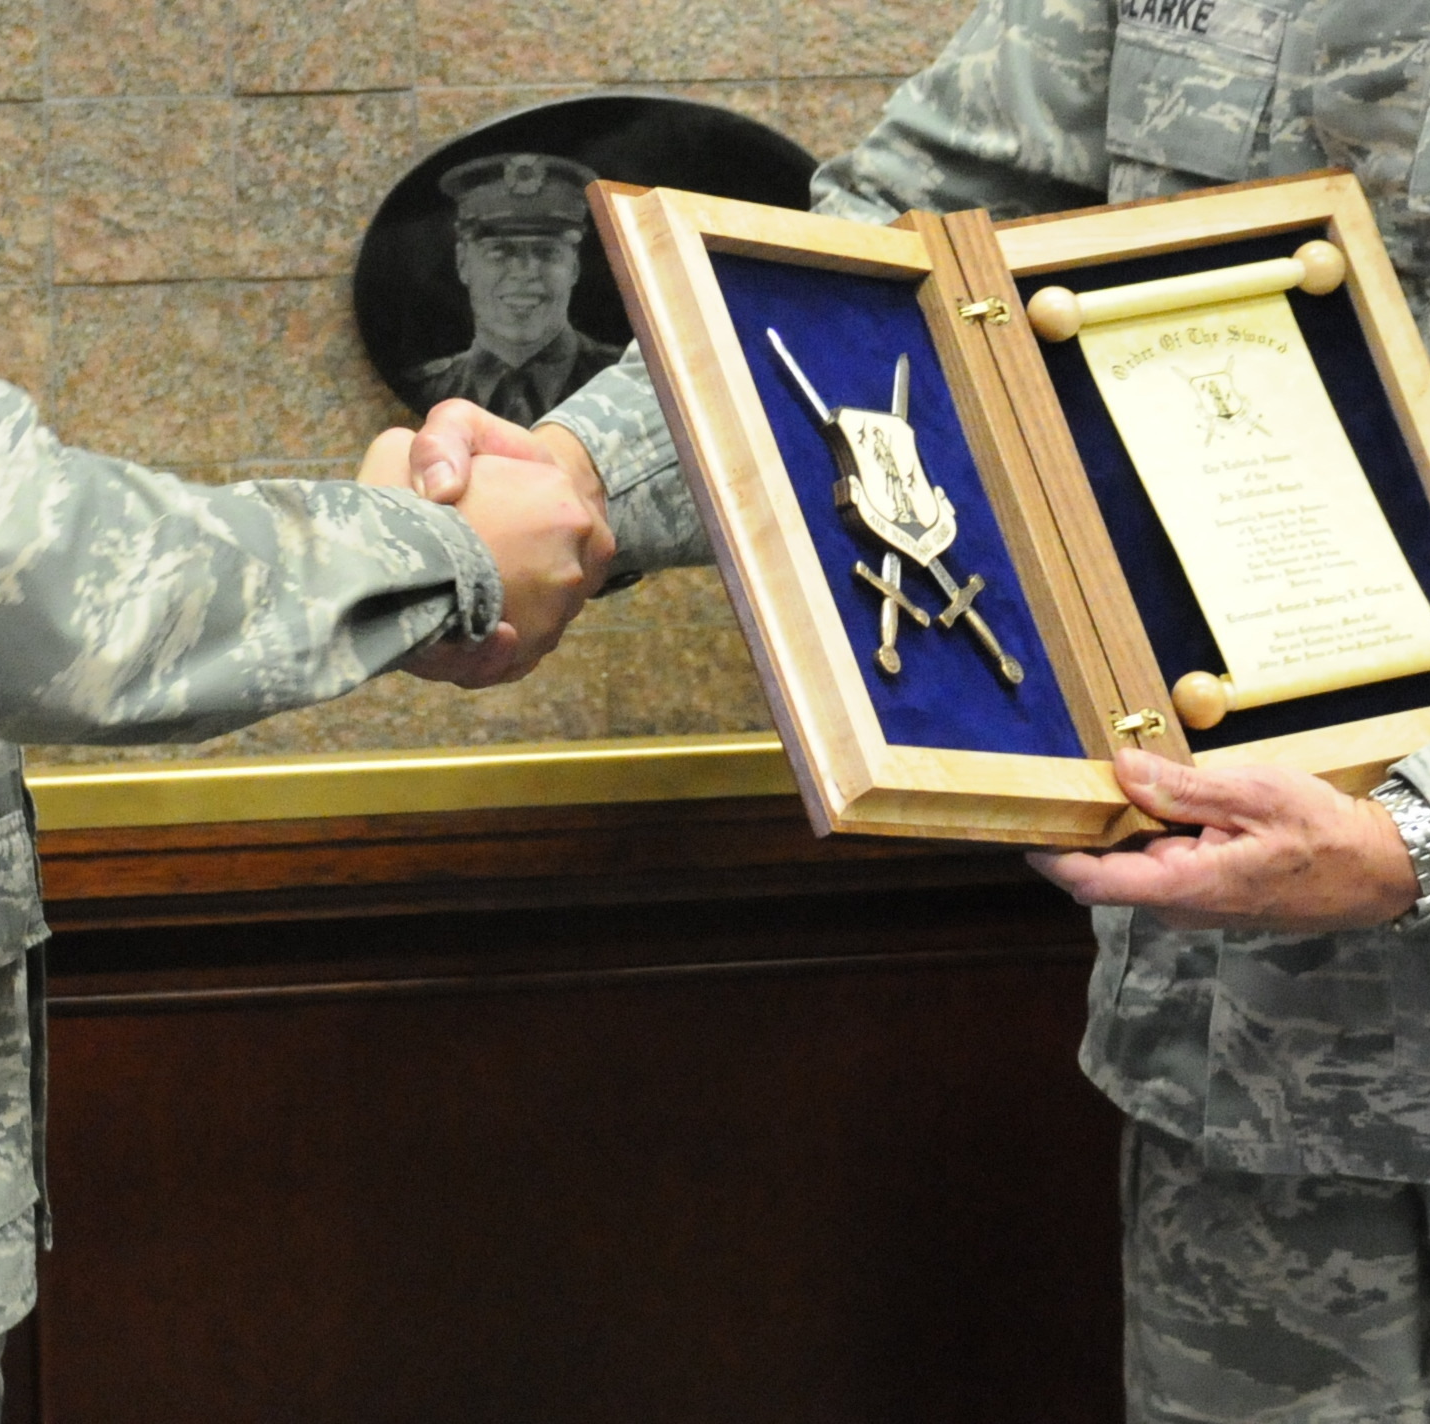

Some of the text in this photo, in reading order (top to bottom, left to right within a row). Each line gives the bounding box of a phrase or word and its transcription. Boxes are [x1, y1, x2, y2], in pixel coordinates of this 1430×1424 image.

[1111, 324, 1288, 381] Order Of The Sword
